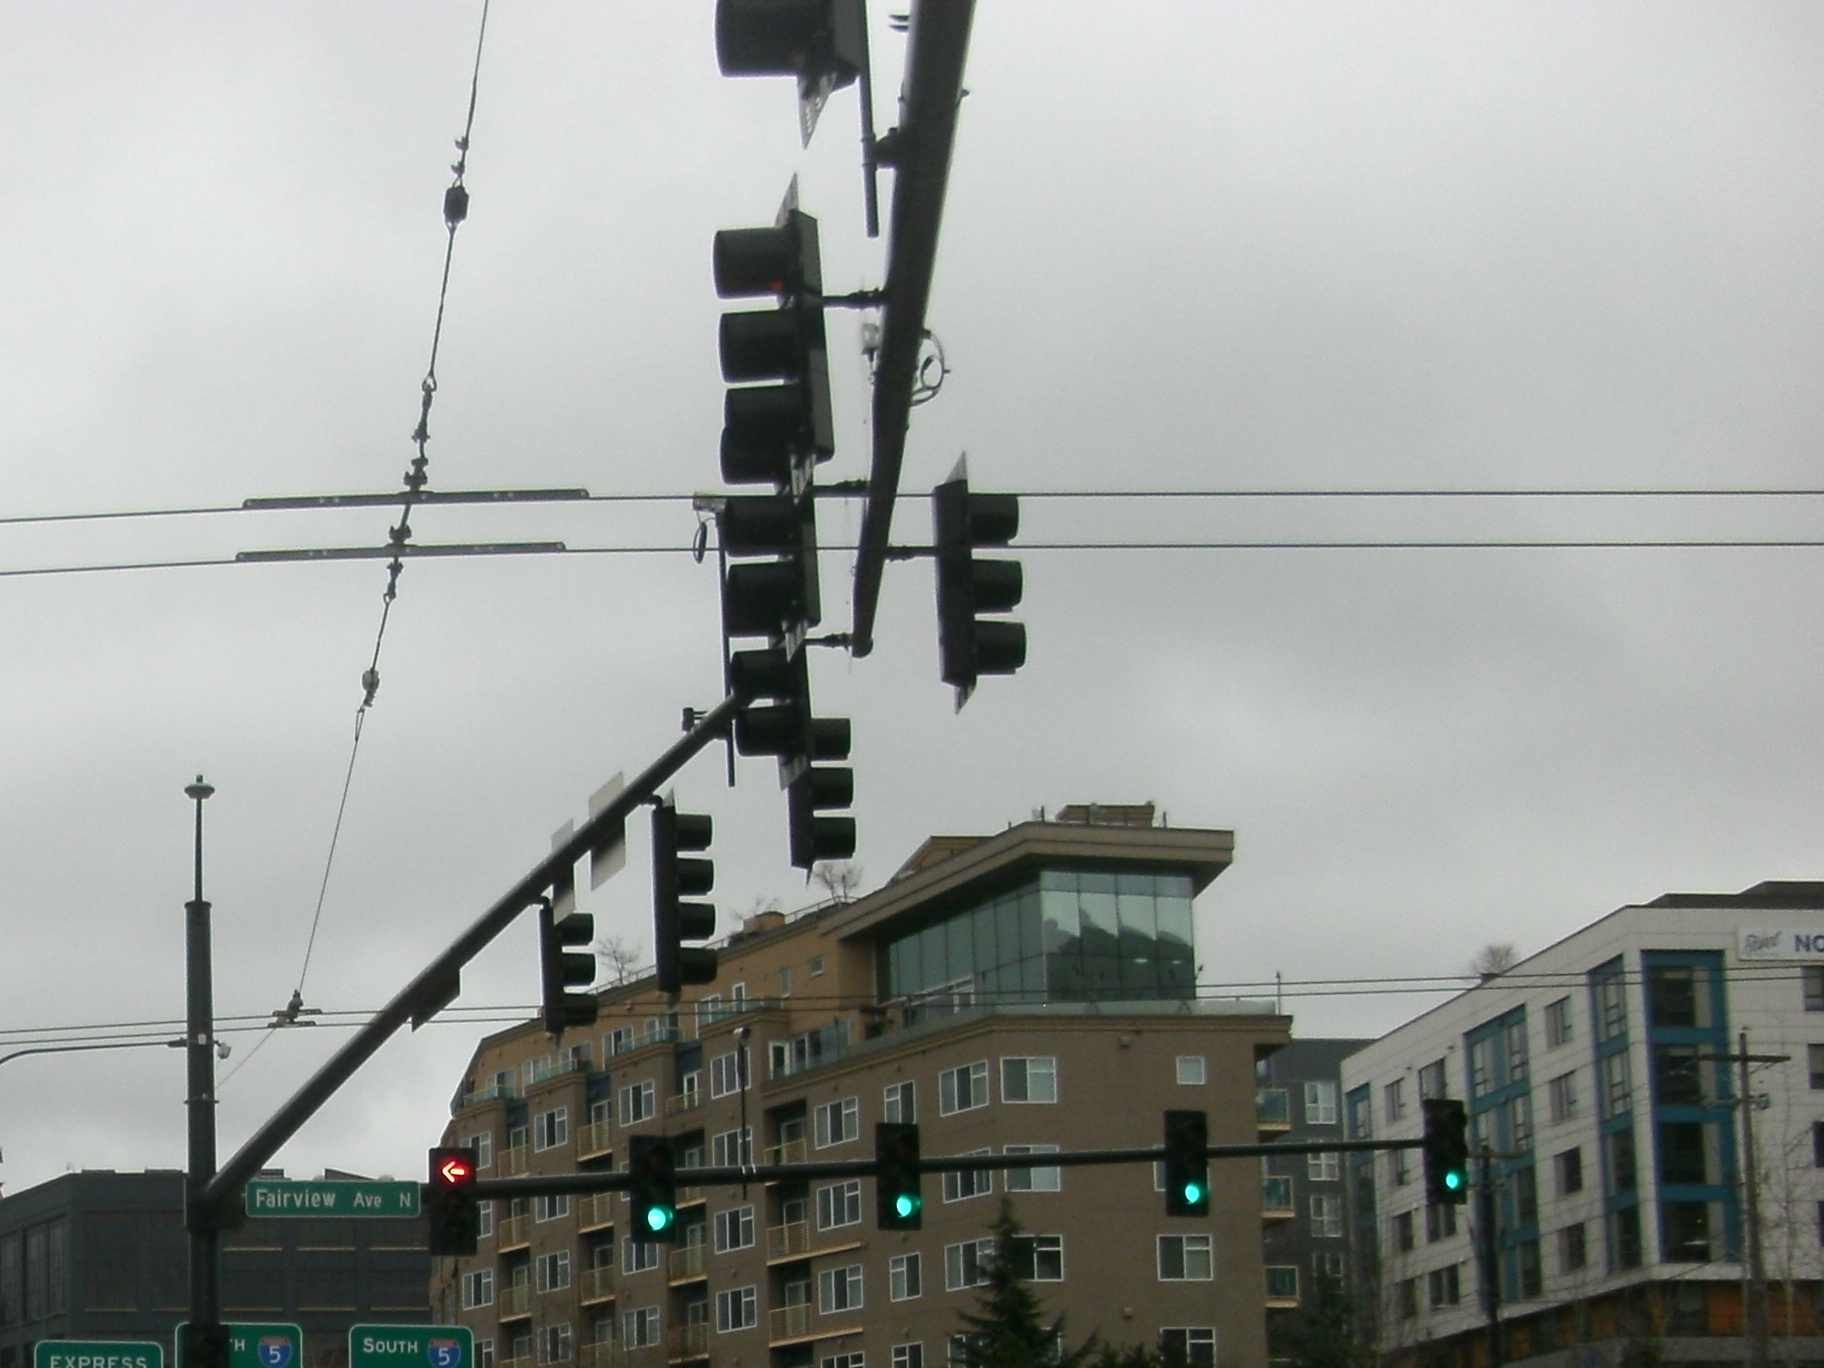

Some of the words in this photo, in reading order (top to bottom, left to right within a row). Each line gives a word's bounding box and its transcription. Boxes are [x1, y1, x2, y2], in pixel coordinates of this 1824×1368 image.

[256, 1188, 336, 1208] Fairview
[353, 1192, 382, 1208] Ave
[399, 1192, 411, 1208] N
[268, 1345, 281, 1364] 5
[438, 1347, 451, 1366] 5
